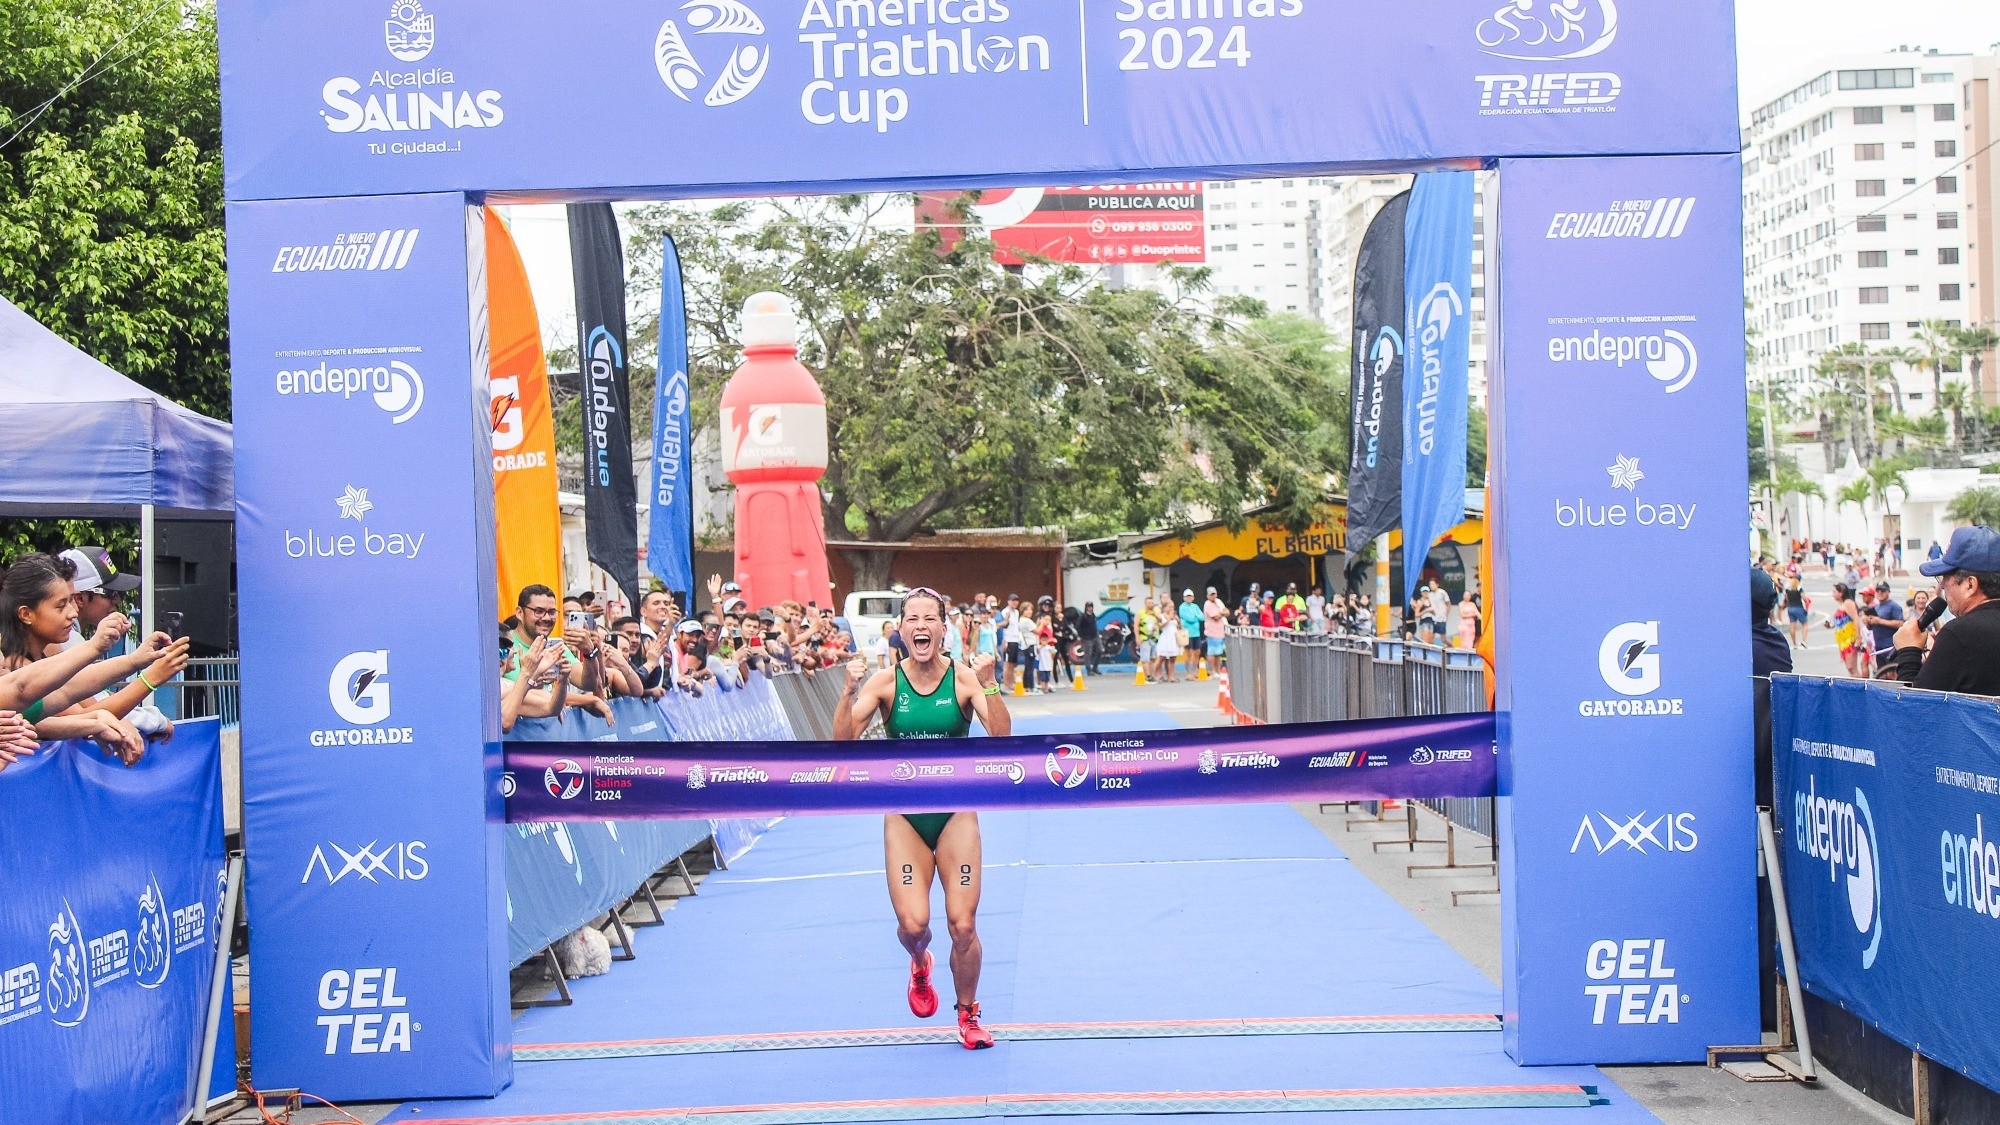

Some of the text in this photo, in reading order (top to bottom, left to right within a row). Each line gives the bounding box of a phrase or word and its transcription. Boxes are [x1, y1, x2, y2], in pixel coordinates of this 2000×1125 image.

[799, 0, 1010, 29] Americas
[799, 27, 1050, 79] Triathlon
[1118, 26, 1251, 71] 2024
[369, 67, 455, 89] Alcaldía
[1474, 72, 1622, 107] TRIFED
[319, 76, 505, 133] SALINAS
[800, 80, 909, 133] Cup
[1479, 107, 1522, 116] FEDERACIÓN
[1524, 107, 1571, 116] ECUATORIANA
[1583, 105, 1616, 113] TRIATLÓN
[368, 143, 387, 155] Tu
[1088, 194, 1195, 210] PUBLICA AQUÍ
[1611, 199, 1652, 211] EL NUEVO
[1545, 210, 1646, 239] ECUADOR
[335, 232, 375, 245] EL NUEVO
[272, 243, 369, 272] ECUADOR
[1597, 316, 1620, 324] DEPORTE
[1626, 315, 1660, 323] PRODUCCION
[1662, 314, 1697, 322] AUDIOVISUAL
[323, 348, 346, 356] DEPORTE
[353, 347, 387, 355] PRODUCCION
[388, 345, 422, 353] AUDIOVISUAL
[1548, 329, 1663, 367] endepro
[276, 361, 390, 399] endepro
[591, 360, 615, 487] endepro
[493, 451, 546, 472] ORADE
[1555, 496, 1697, 530] blue bay
[285, 526, 425, 559] blue bay
[1256, 537, 1280, 554] EL
[1579, 699, 1683, 716] GATORADE
[310, 727, 414, 747] GATORADE
[1100, 738, 1144, 748] Americas
[594, 754, 634, 764] Americas
[1100, 749, 1179, 763] Triathlon Cup
[1221, 752, 1280, 768] Triatlón
[1309, 757, 1347, 768] ECUADOR
[1436, 750, 1472, 760] TRIFED
[594, 765, 665, 777] Triathlon Cup
[710, 768, 769, 784] Triatlón
[790, 771, 829, 783] ECUADOR
[918, 765, 954, 775] TRIFED
[975, 762, 1014, 775] endepro
[1101, 764, 1143, 775] Salinas
[594, 778, 632, 788] Salinas
[1101, 777, 1131, 789] 2024
[594, 790, 622, 801] 2024
[1569, 810, 1699, 856] AXXIS
[1795, 774, 1857, 882] endepro
[301, 838, 429, 884] AXXIS
[1941, 813, 2000, 919] ende
[172, 901, 205, 944] TRIFED
[89, 928, 129, 978] TRIFED
[1586, 938, 1675, 980] GEL
[0, 962, 41, 1013] IFED
[318, 967, 407, 1010] GEL
